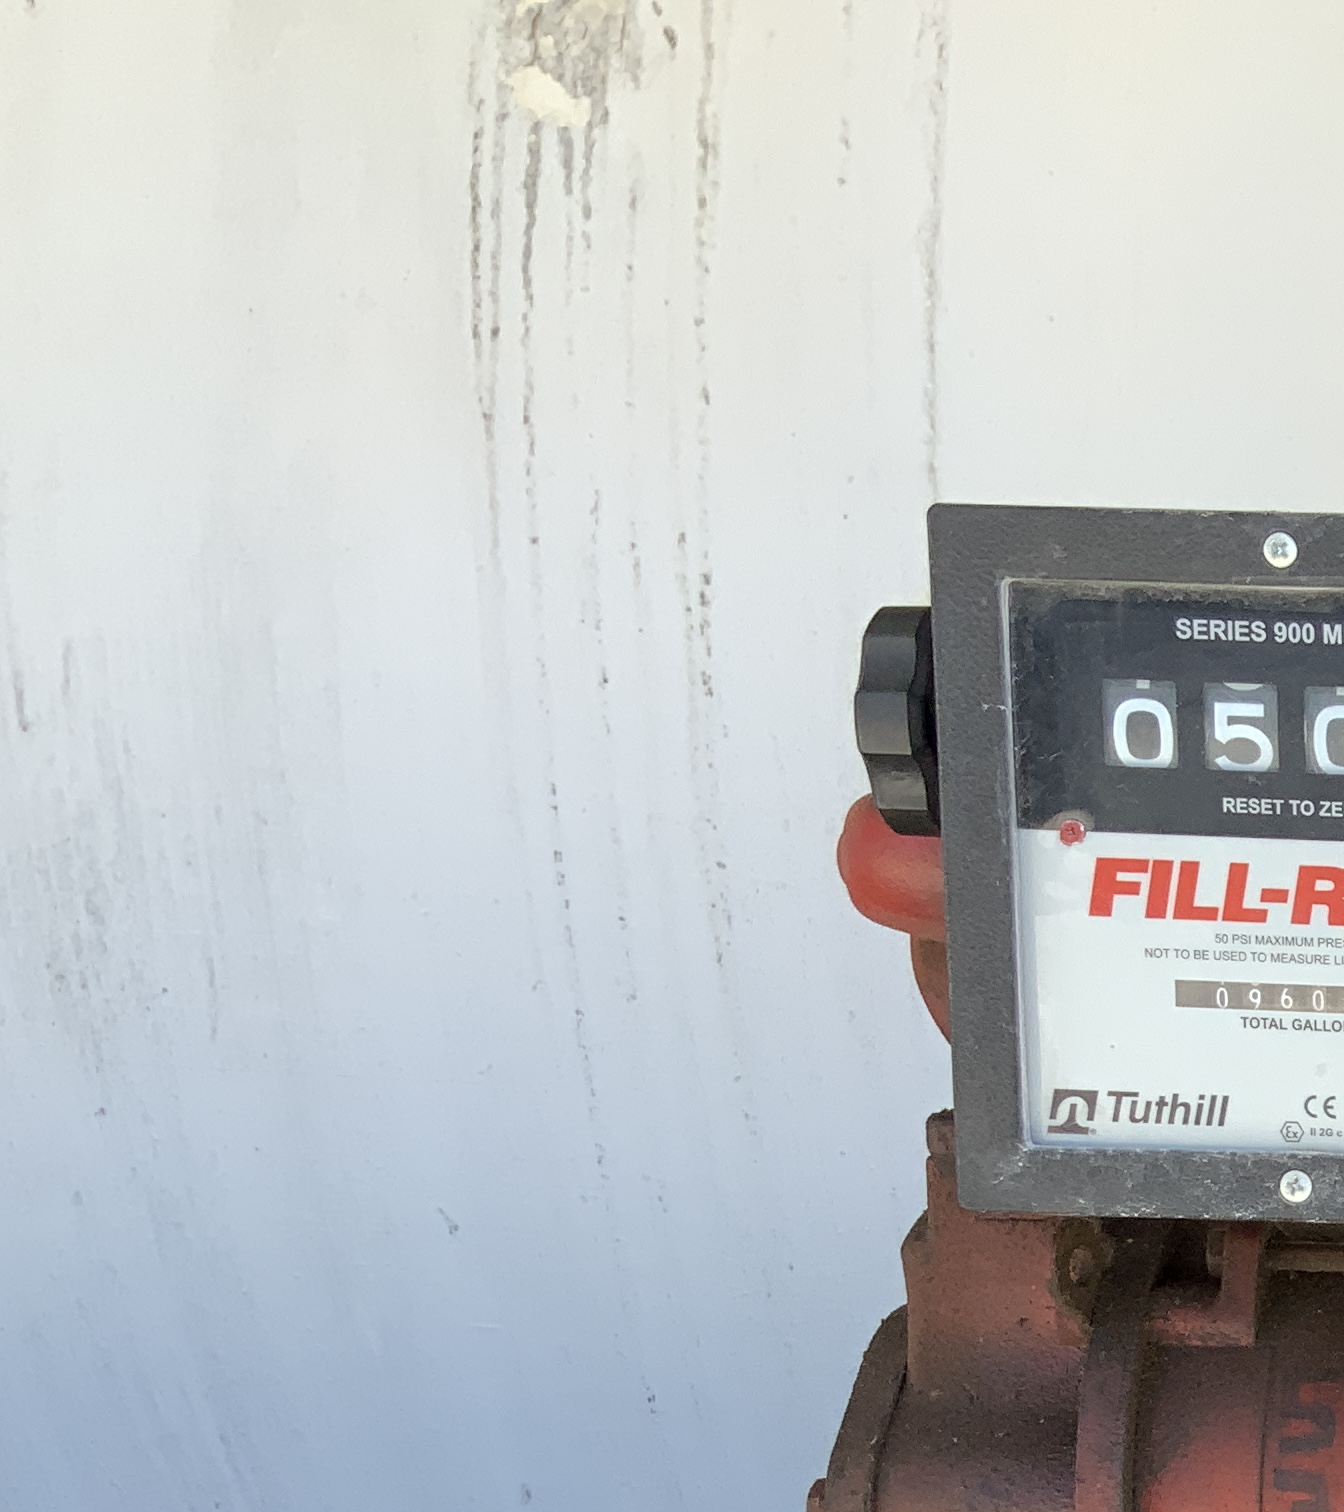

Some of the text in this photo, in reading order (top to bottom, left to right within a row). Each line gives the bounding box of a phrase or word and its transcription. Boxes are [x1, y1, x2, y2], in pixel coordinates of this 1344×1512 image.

[1176, 618, 1266, 642] SERIES
[1274, 622, 1314, 643] 900
[1213, 701, 1274, 772] 5
[1223, 798, 1284, 814] RESET
[1289, 800, 1314, 816] TO
[1214, 934, 1229, 944] 50
[1232, 935, 1251, 945] PSI
[1255, 935, 1315, 947] MAXIMUM
[1144, 948, 1170, 959] NOT
[1173, 949, 1190, 960] TO
[1194, 950, 1210, 960] BE
[1213, 950, 1247, 962] USED
[1250, 951, 1267, 962] TO
[1270, 953, 1331, 965] MEASURE
[1241, 1017, 1287, 1030] TOTAL
[1108, 1091, 1229, 1126] Tuthill
[1319, 1128, 1334, 1137] 2G
